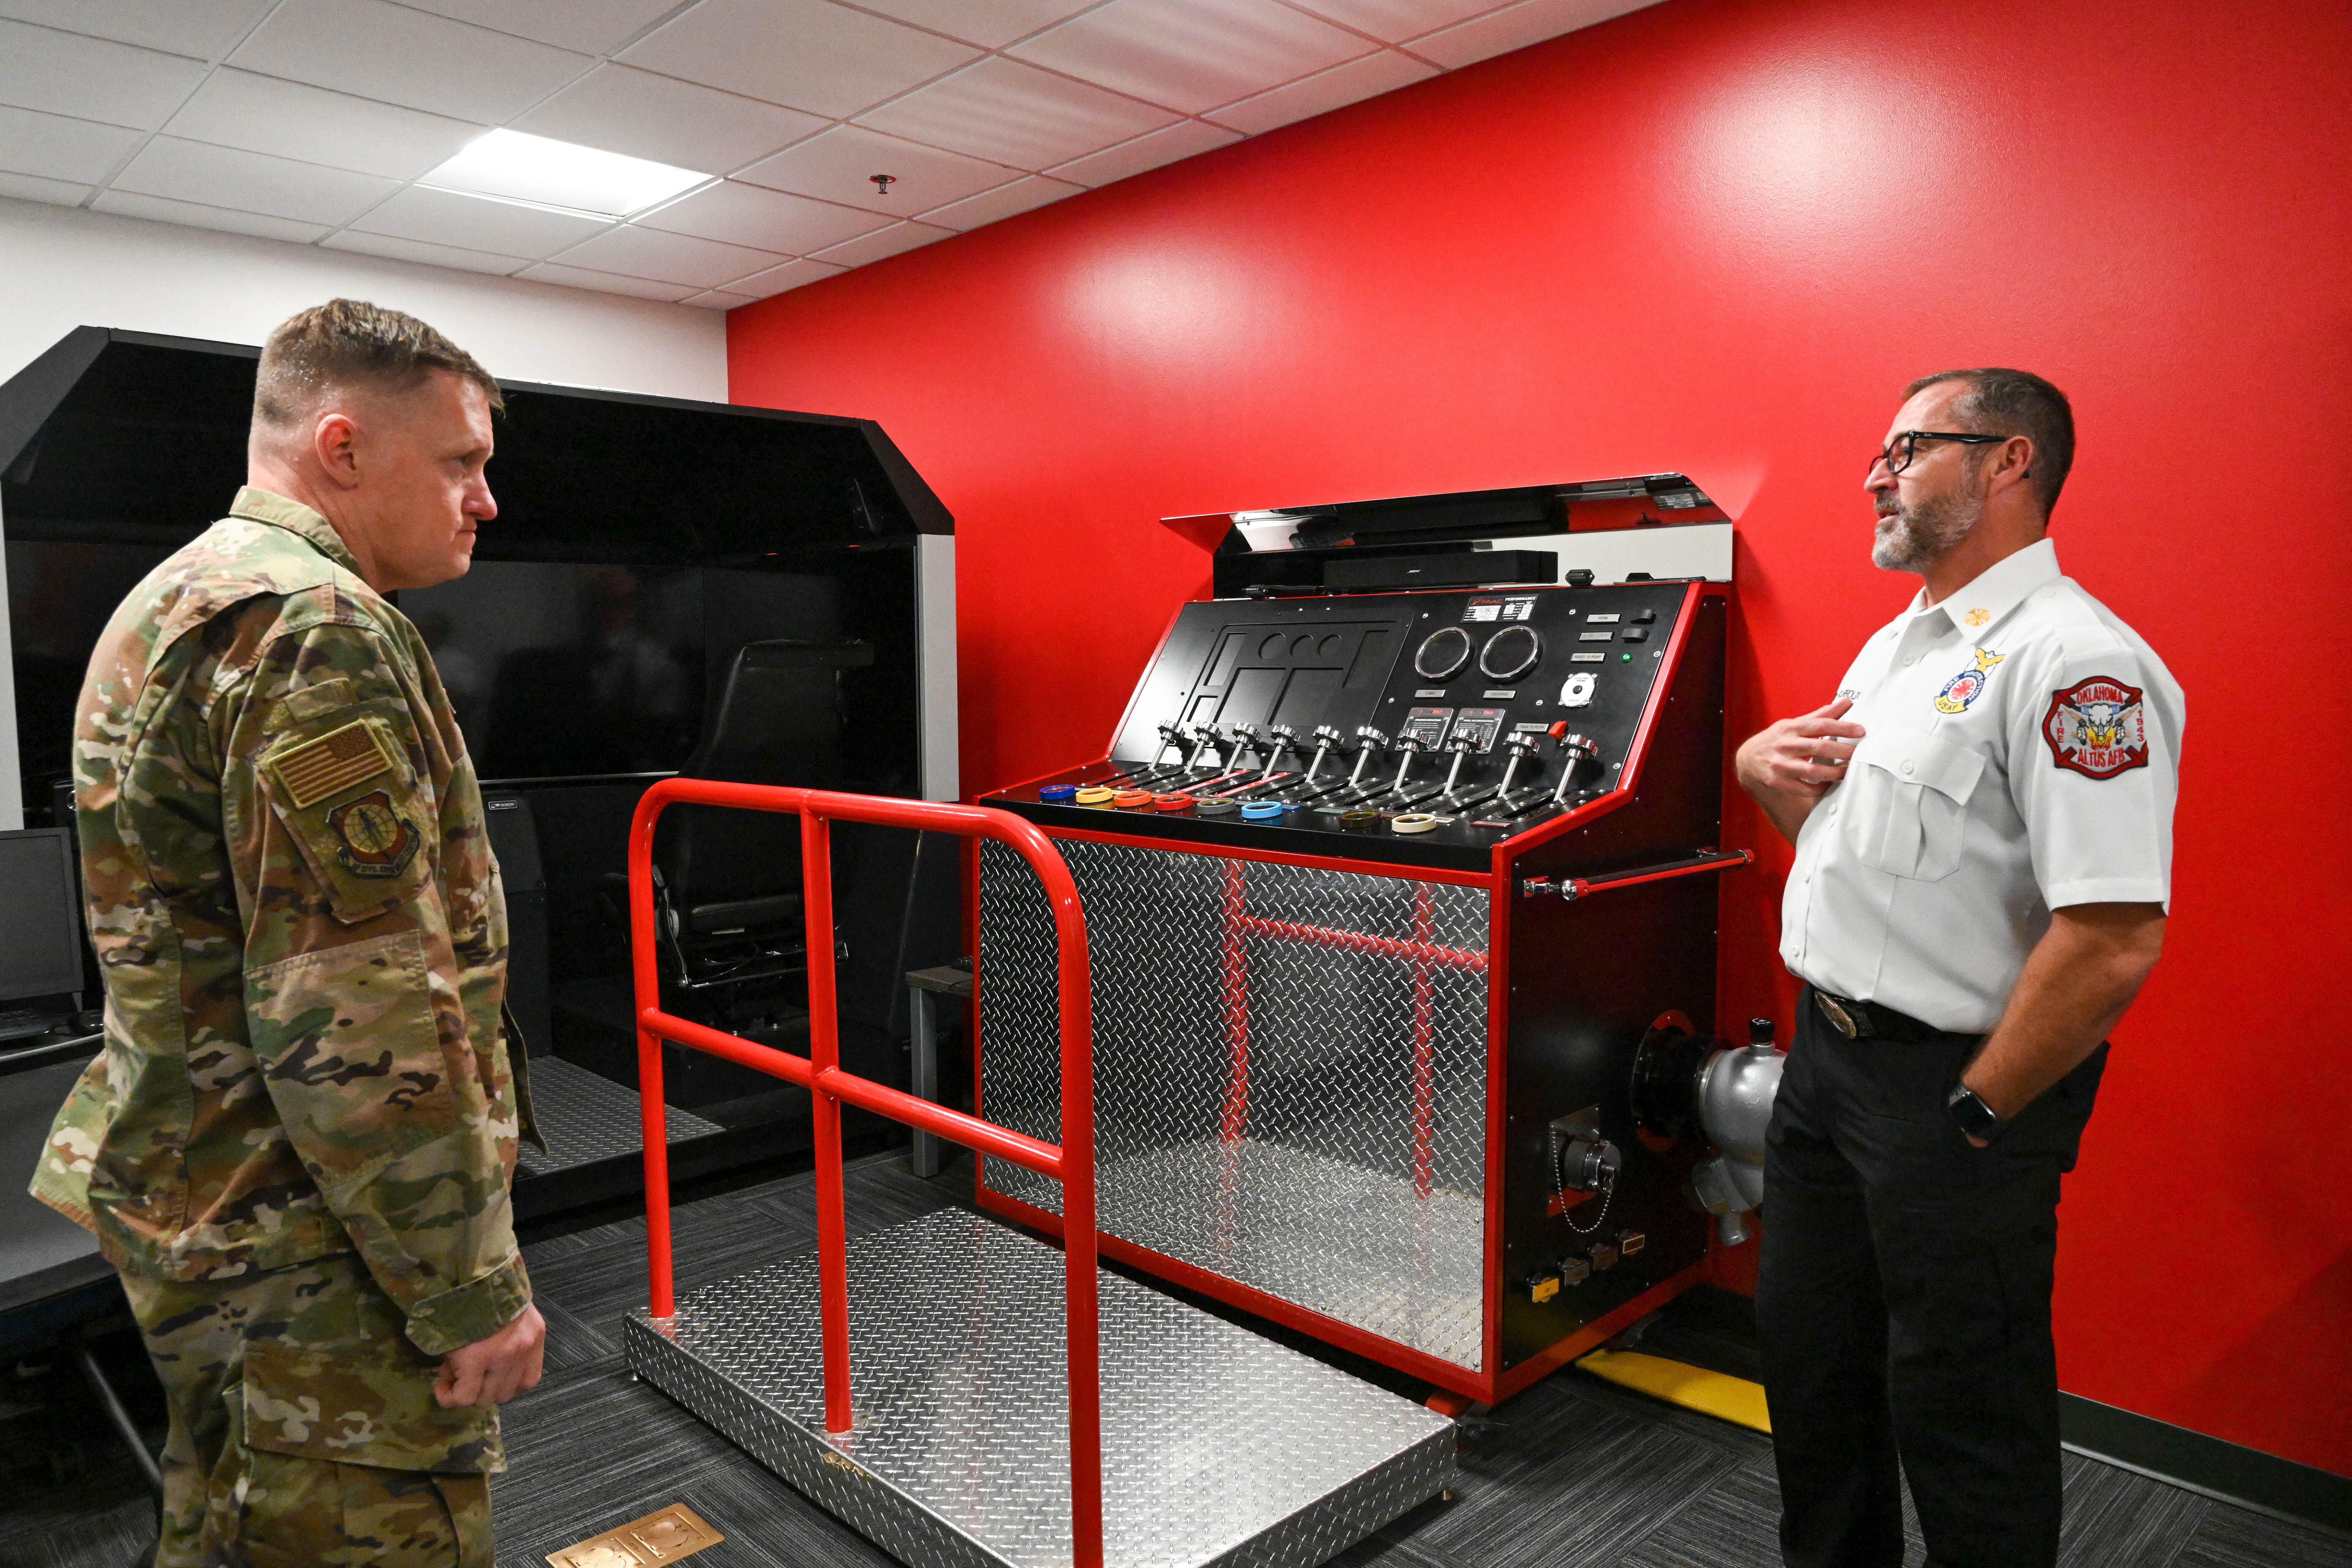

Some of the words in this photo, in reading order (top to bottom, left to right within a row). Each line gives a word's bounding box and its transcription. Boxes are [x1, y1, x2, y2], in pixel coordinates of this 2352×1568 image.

[1944, 677, 1960, 691] FIRE
[1964, 671, 1983, 701] PROTECTION
[2077, 685, 2124, 704] OKLAHOMA
[1938, 700, 1959, 711] USAF
[2056, 711, 2065, 743] FIRE
[2136, 710, 2144, 741] 1943
[2078, 748, 2106, 767] ALTUS
[2108, 748, 2126, 767] AFB
